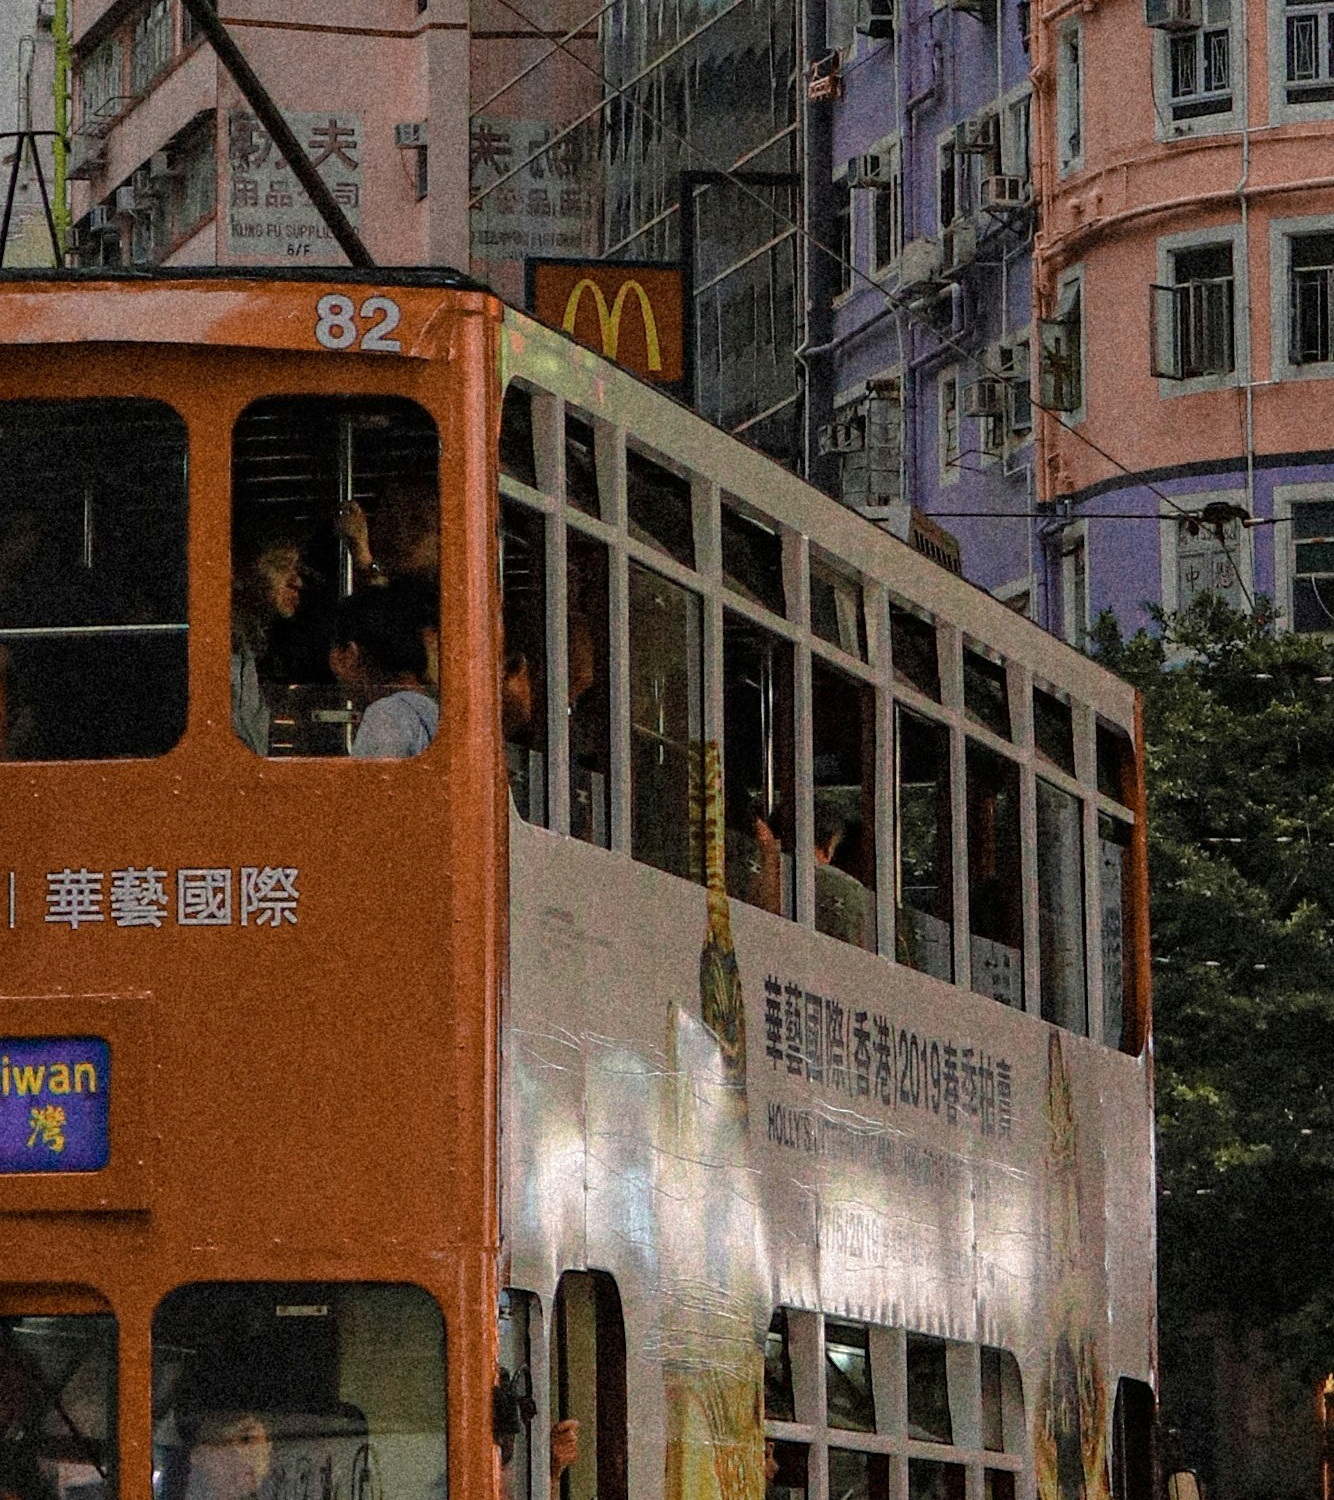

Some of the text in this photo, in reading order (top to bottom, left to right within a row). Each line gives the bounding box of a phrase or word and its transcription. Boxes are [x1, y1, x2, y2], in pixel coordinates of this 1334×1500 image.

[314, 293, 402, 353] 82
[44, 867, 300, 930] 華藝國際
